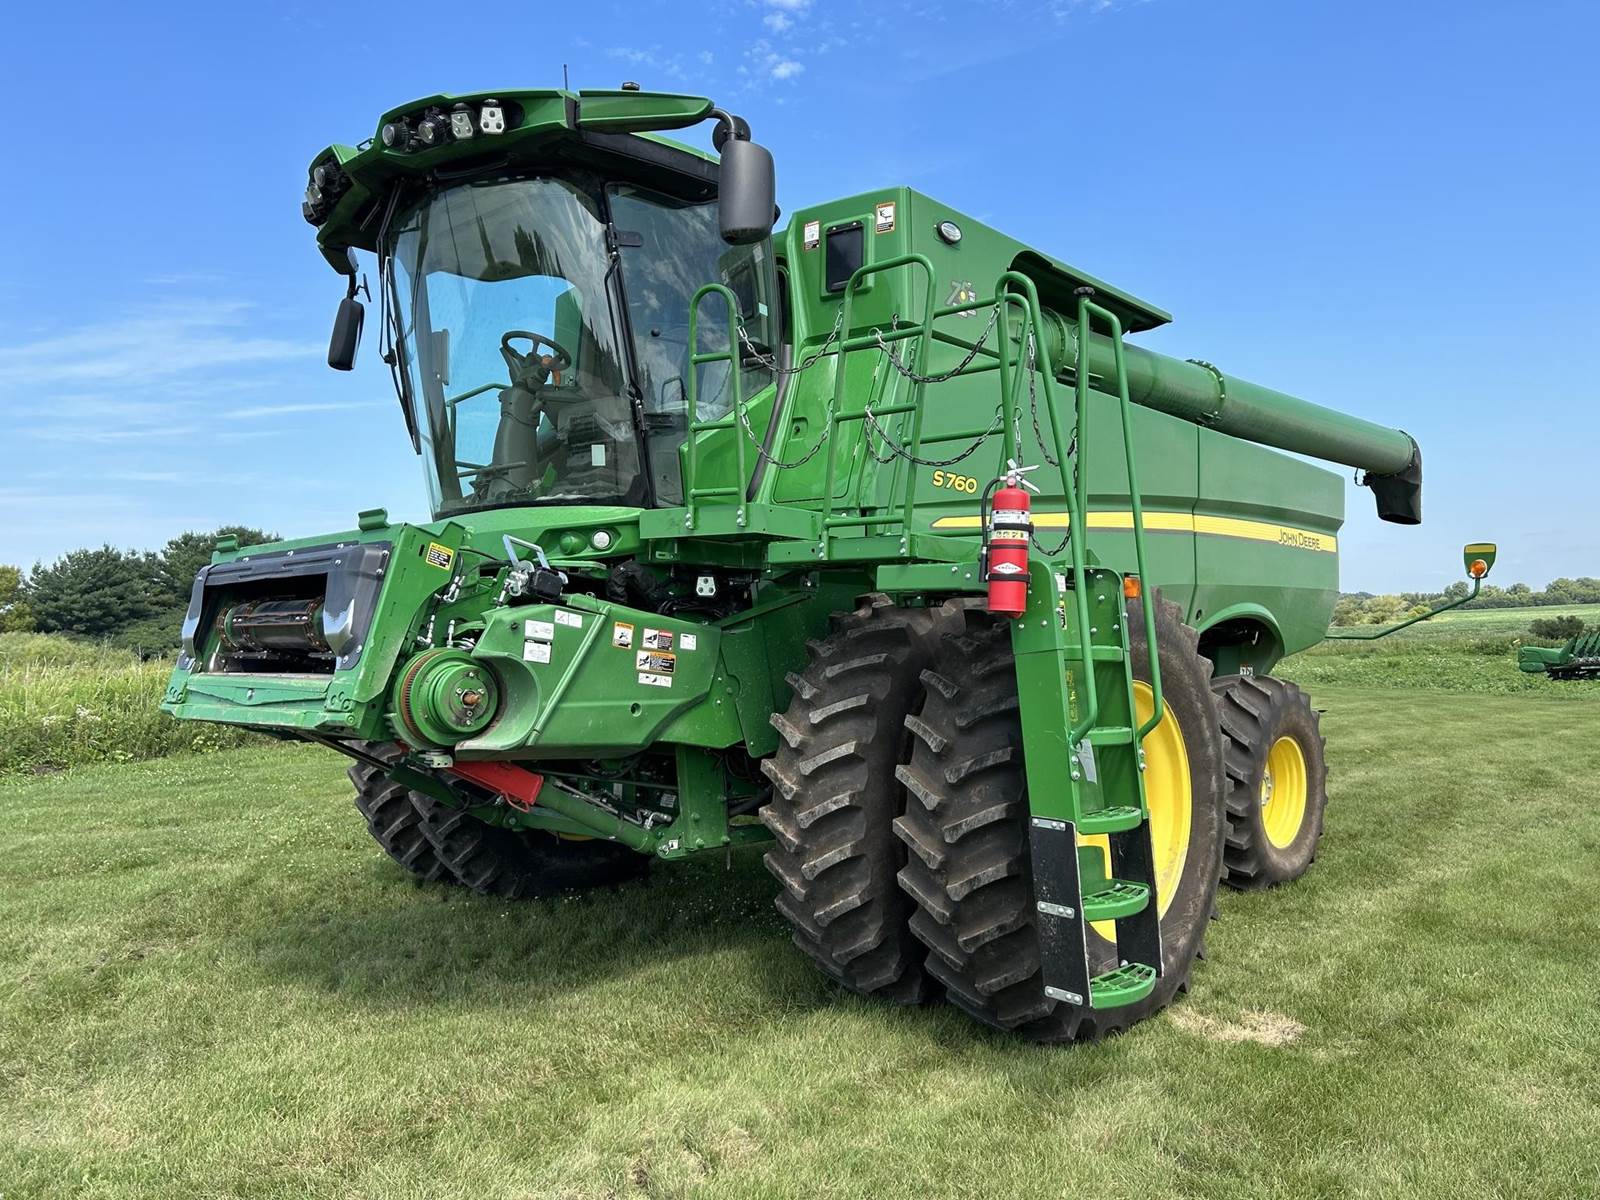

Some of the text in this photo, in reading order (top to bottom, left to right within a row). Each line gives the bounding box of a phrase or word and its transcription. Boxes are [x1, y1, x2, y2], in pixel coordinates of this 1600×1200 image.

[933, 470, 978, 494] S760
[1279, 529, 1321, 550] JOHN DEERE
